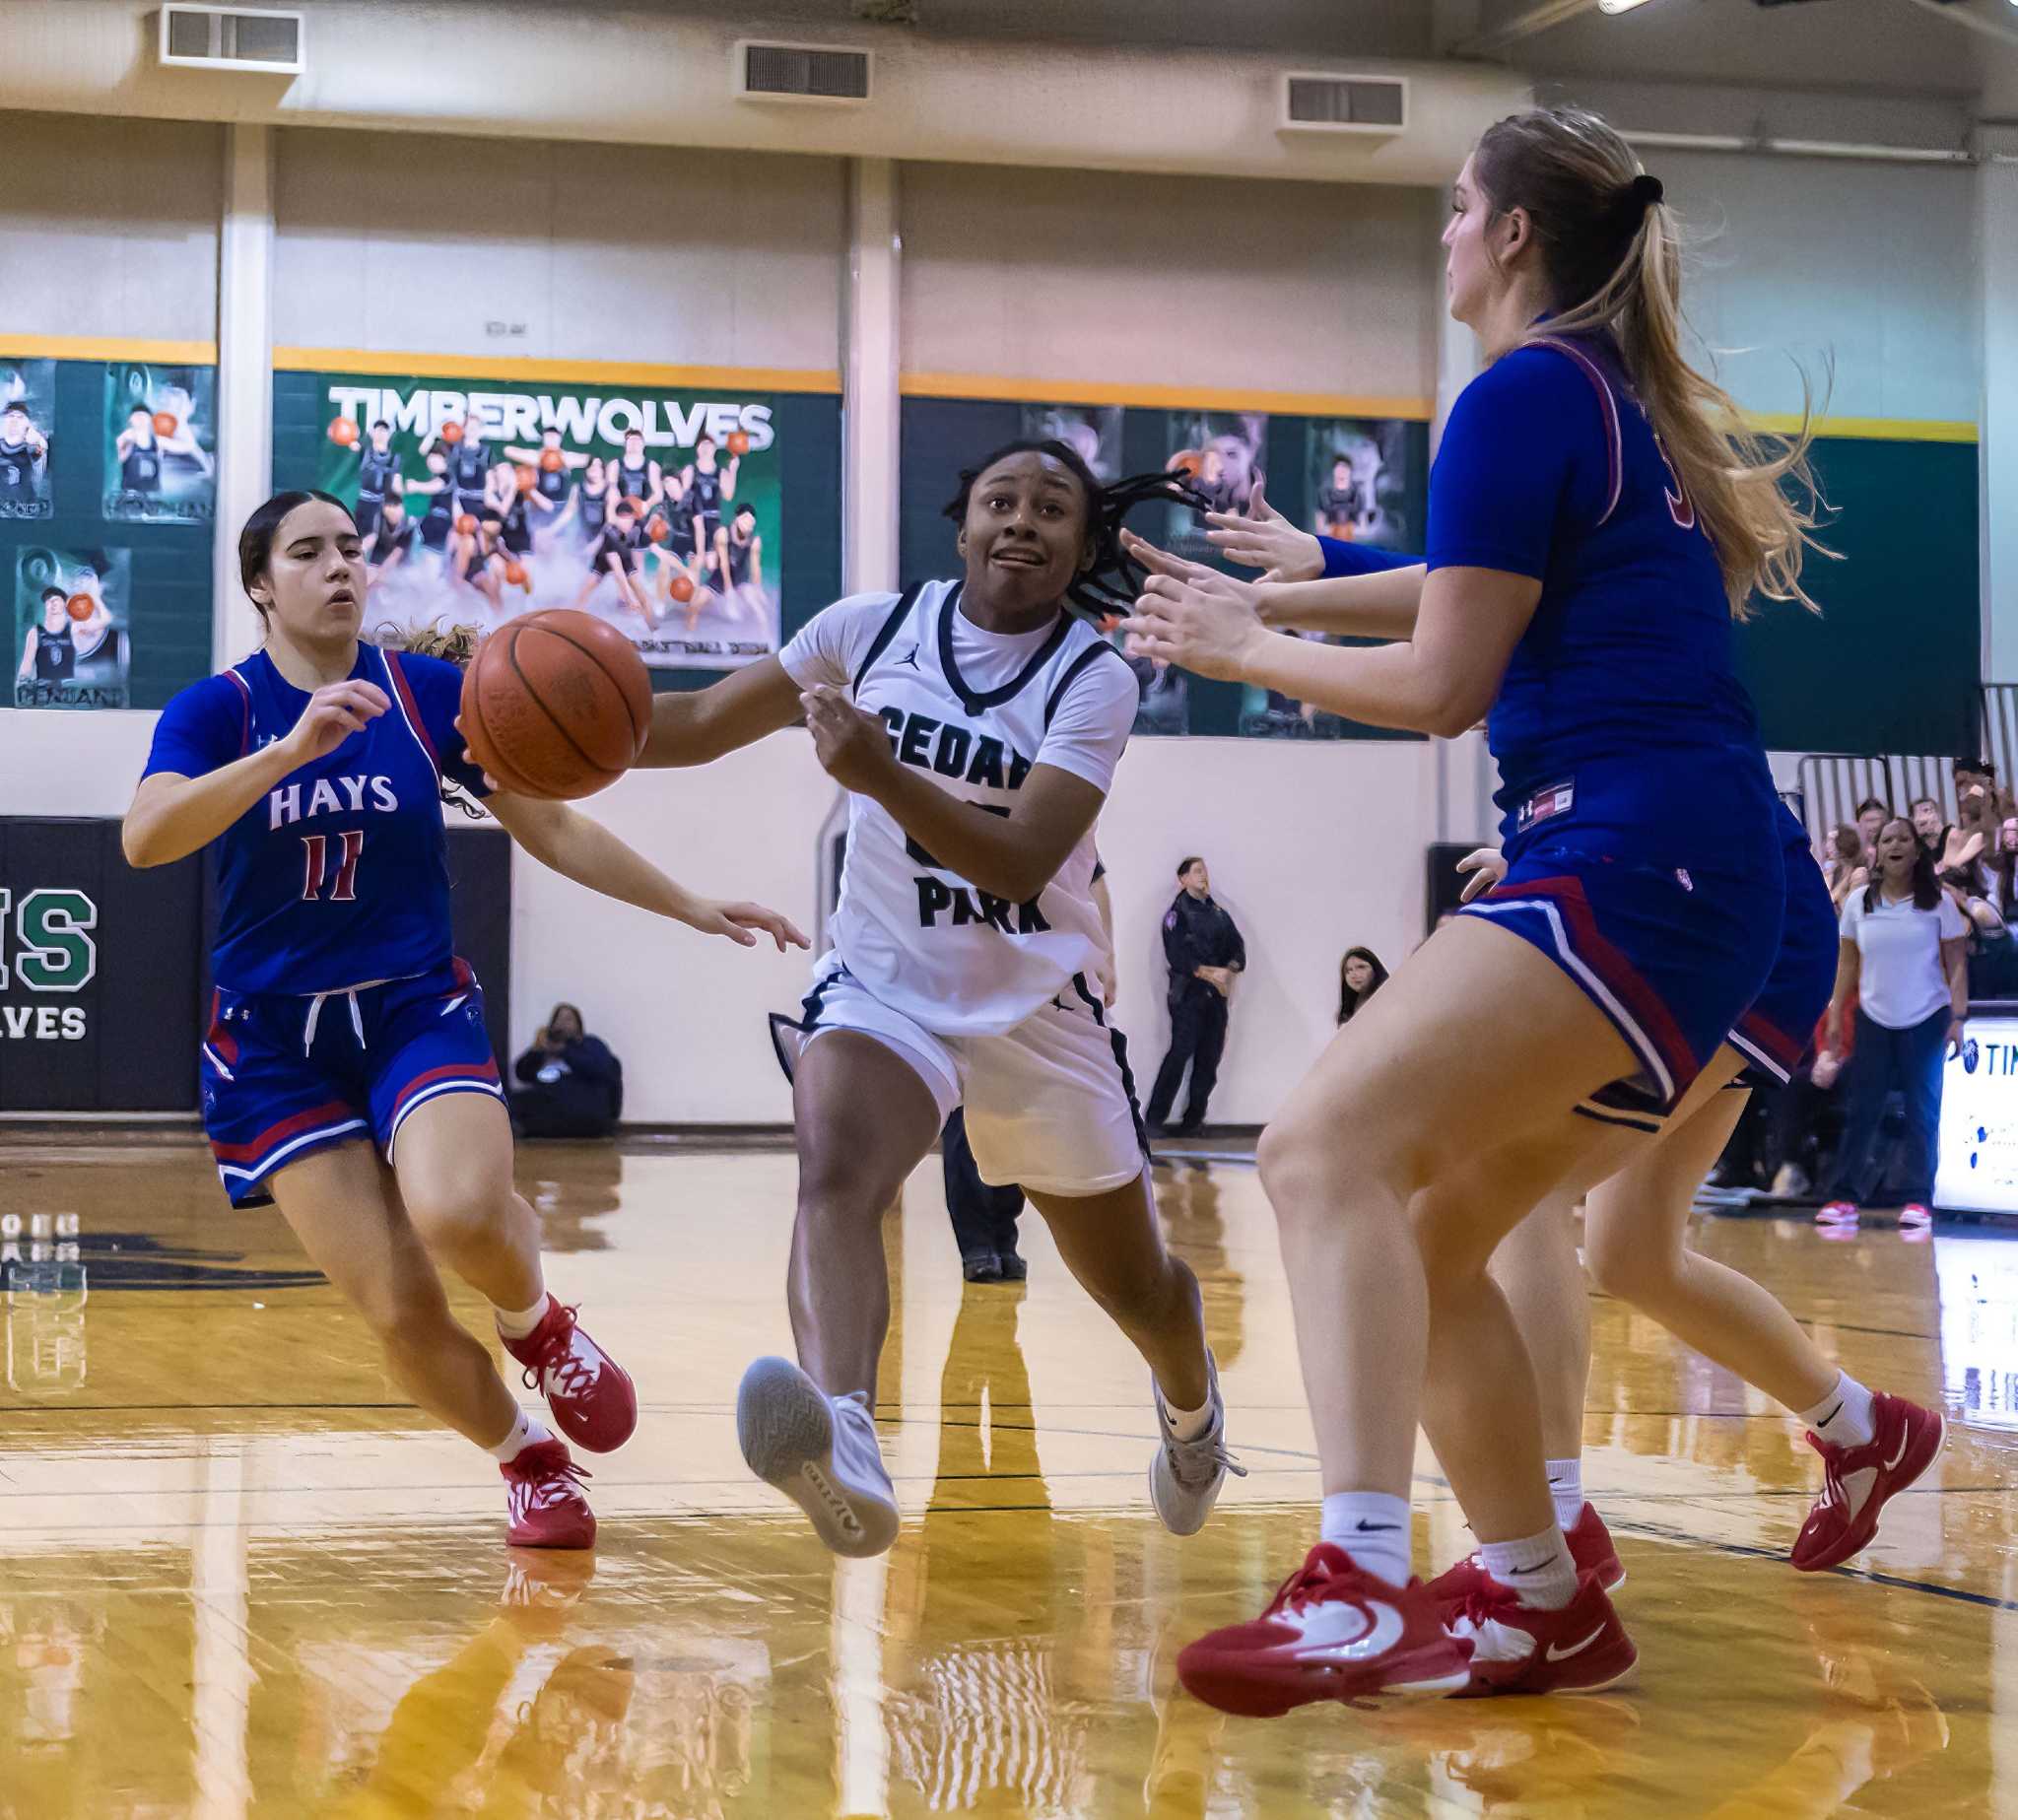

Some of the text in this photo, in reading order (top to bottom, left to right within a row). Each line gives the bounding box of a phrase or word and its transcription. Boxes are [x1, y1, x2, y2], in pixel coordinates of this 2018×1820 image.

[328, 386, 775, 451] TIMBERWOLVES
[269, 775, 398, 831] HAYS
[300, 830, 364, 901] 11
[913, 876, 1051, 934] PARK
[0, 1006, 87, 1040] VES
